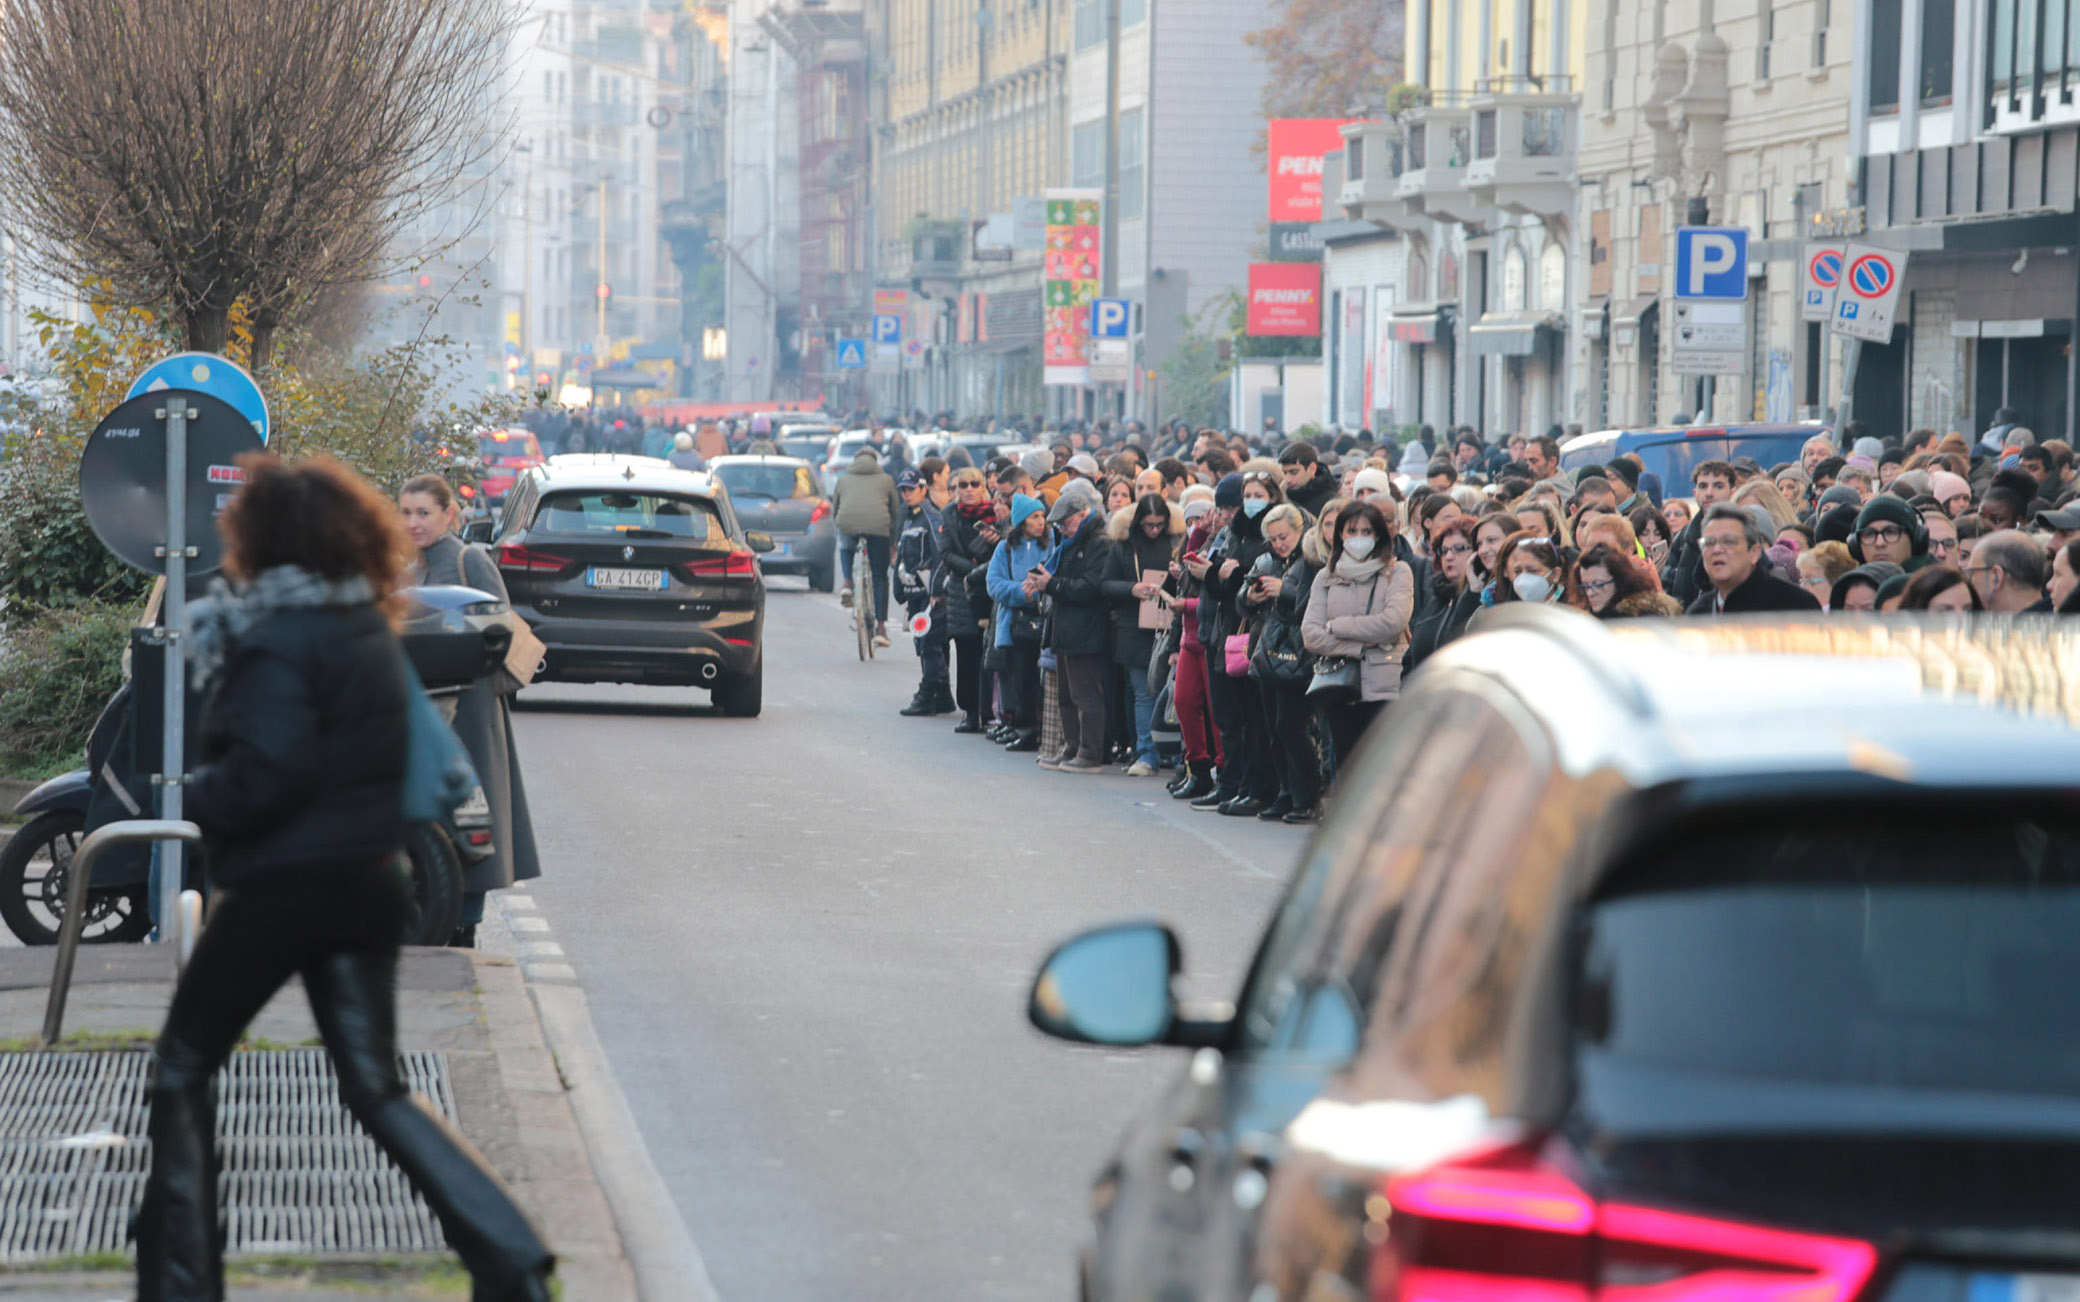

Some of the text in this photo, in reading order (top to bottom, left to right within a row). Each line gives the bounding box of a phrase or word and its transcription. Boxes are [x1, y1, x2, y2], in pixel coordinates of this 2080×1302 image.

[1689, 233, 1737, 295] P
[1098, 301, 1125, 334] P
[1842, 303, 1856, 317] P
[877, 317, 897, 340] P
[596, 570, 613, 585] GA
